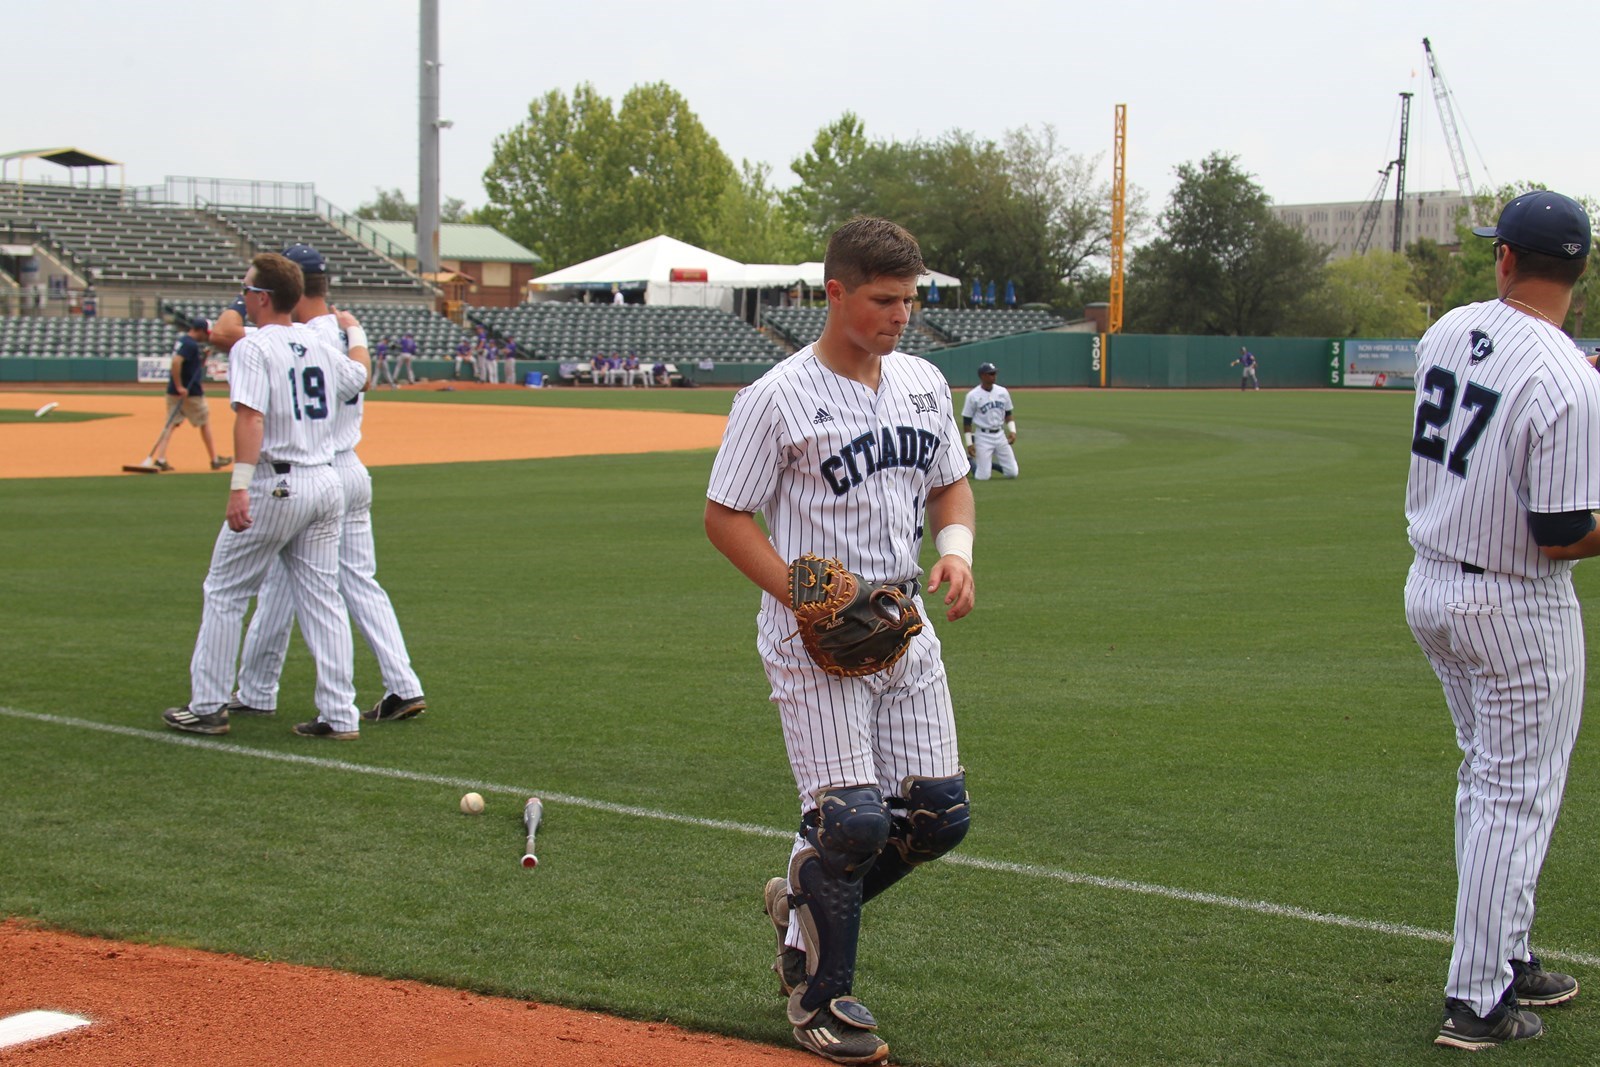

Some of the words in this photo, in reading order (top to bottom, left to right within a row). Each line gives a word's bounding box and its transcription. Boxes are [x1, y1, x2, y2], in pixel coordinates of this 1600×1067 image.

[1092, 336, 1101, 371] 305
[1330, 342, 1340, 384] 345
[288, 366, 328, 421] 19
[813, 416, 834, 425] adidas
[1412, 365, 1502, 480] 27
[821, 426, 941, 497] CITADE
